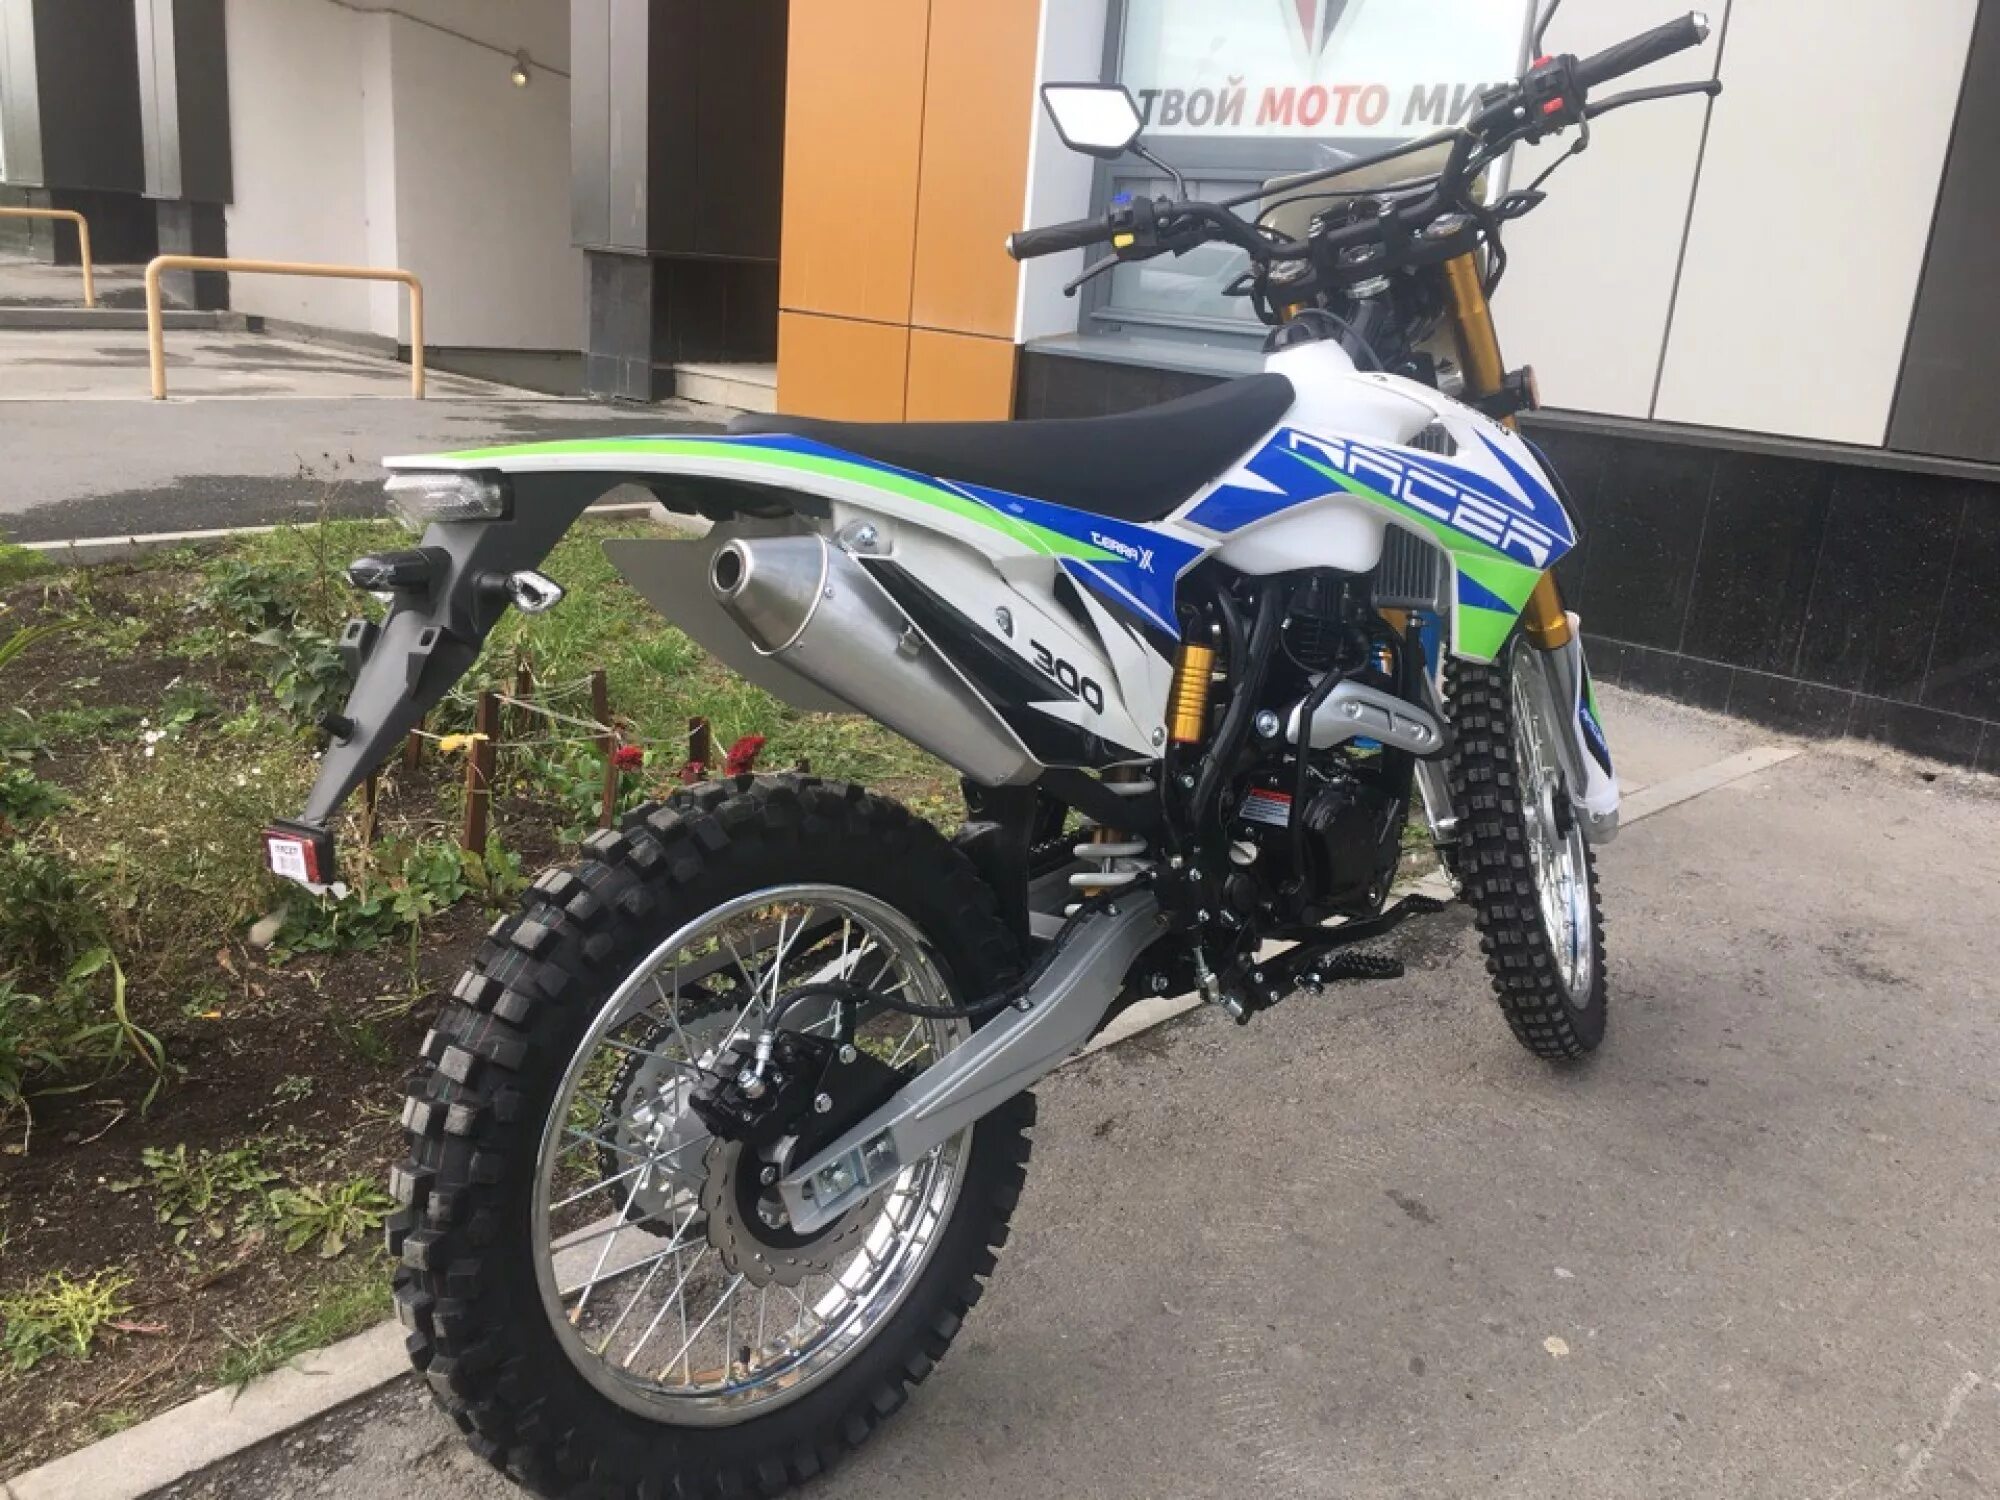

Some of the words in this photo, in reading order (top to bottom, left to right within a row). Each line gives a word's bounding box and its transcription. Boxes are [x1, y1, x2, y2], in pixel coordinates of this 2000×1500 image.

[1138, 75, 1247, 126] ТВОЙ
[1255, 84, 1390, 127] МОТО
[1401, 82, 1505, 126] МИ
[1289, 431, 1553, 568] RACER
[1029, 639, 1104, 715] 300
